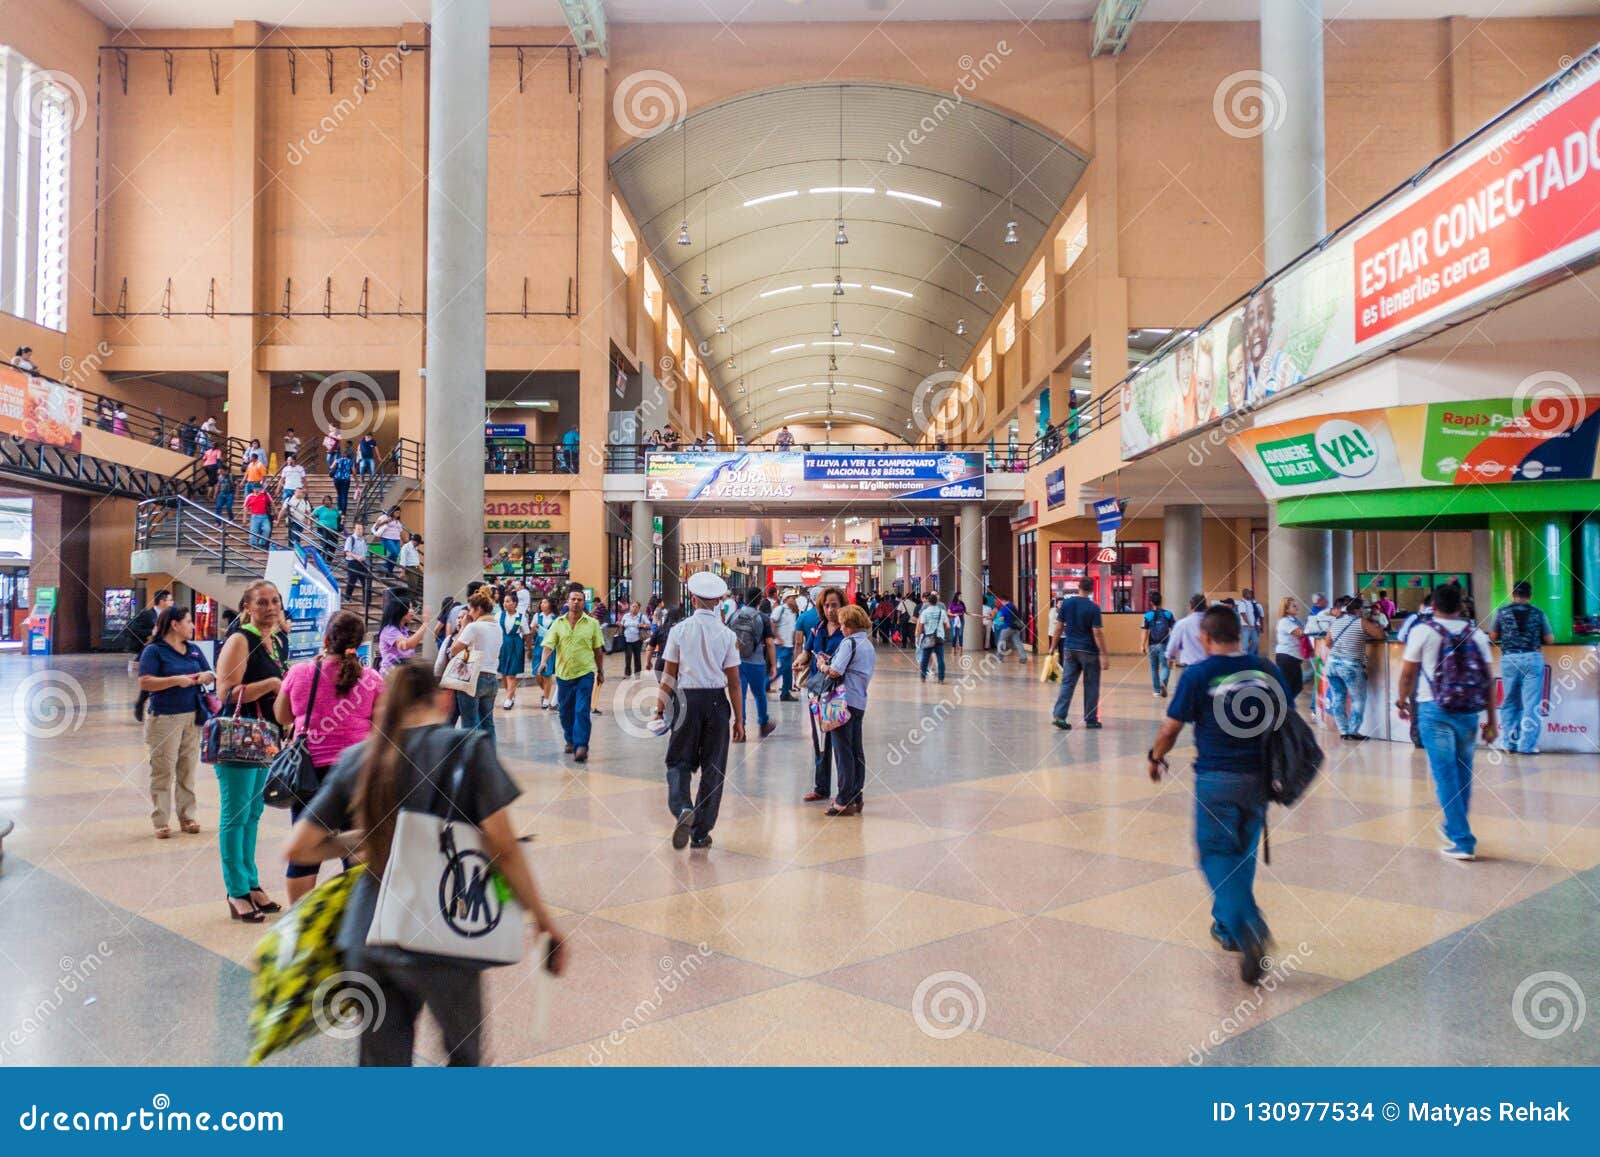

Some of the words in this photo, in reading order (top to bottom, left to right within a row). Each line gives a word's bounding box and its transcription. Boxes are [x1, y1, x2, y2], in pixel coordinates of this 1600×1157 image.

[1361, 228, 1429, 298] ESTAR
[1362, 307, 1378, 328] es
[1380, 272, 1440, 319] tenerlos
[1443, 247, 1490, 287] cerca
[1442, 427, 1478, 436] Terminal
[1262, 443, 1313, 463] ADQUIERE
[1321, 429, 1374, 468] YA!
[806, 459, 815, 467] TE
[816, 459, 840, 467] LLEVA
[841, 459, 848, 467] A
[851, 459, 866, 467] VER
[867, 459, 876, 467] EL
[878, 459, 936, 467] CAMPEONATO
[1269, 465, 1283, 478] TU
[1281, 460, 1320, 477] TARJETA
[827, 468, 870, 476] NACIONAL
[871, 468, 882, 476] DE
[883, 466, 915, 476] BÉISBOL
[727, 471, 767, 484] DURA
[701, 487, 711, 497] 4
[715, 486, 756, 497] VECES
[940, 486, 983, 498] Gillette
[484, 500, 562, 515] anastita
[487, 520, 500, 529] DE
[503, 520, 551, 529] REGALOS
[1547, 722, 1588, 733] Metro
